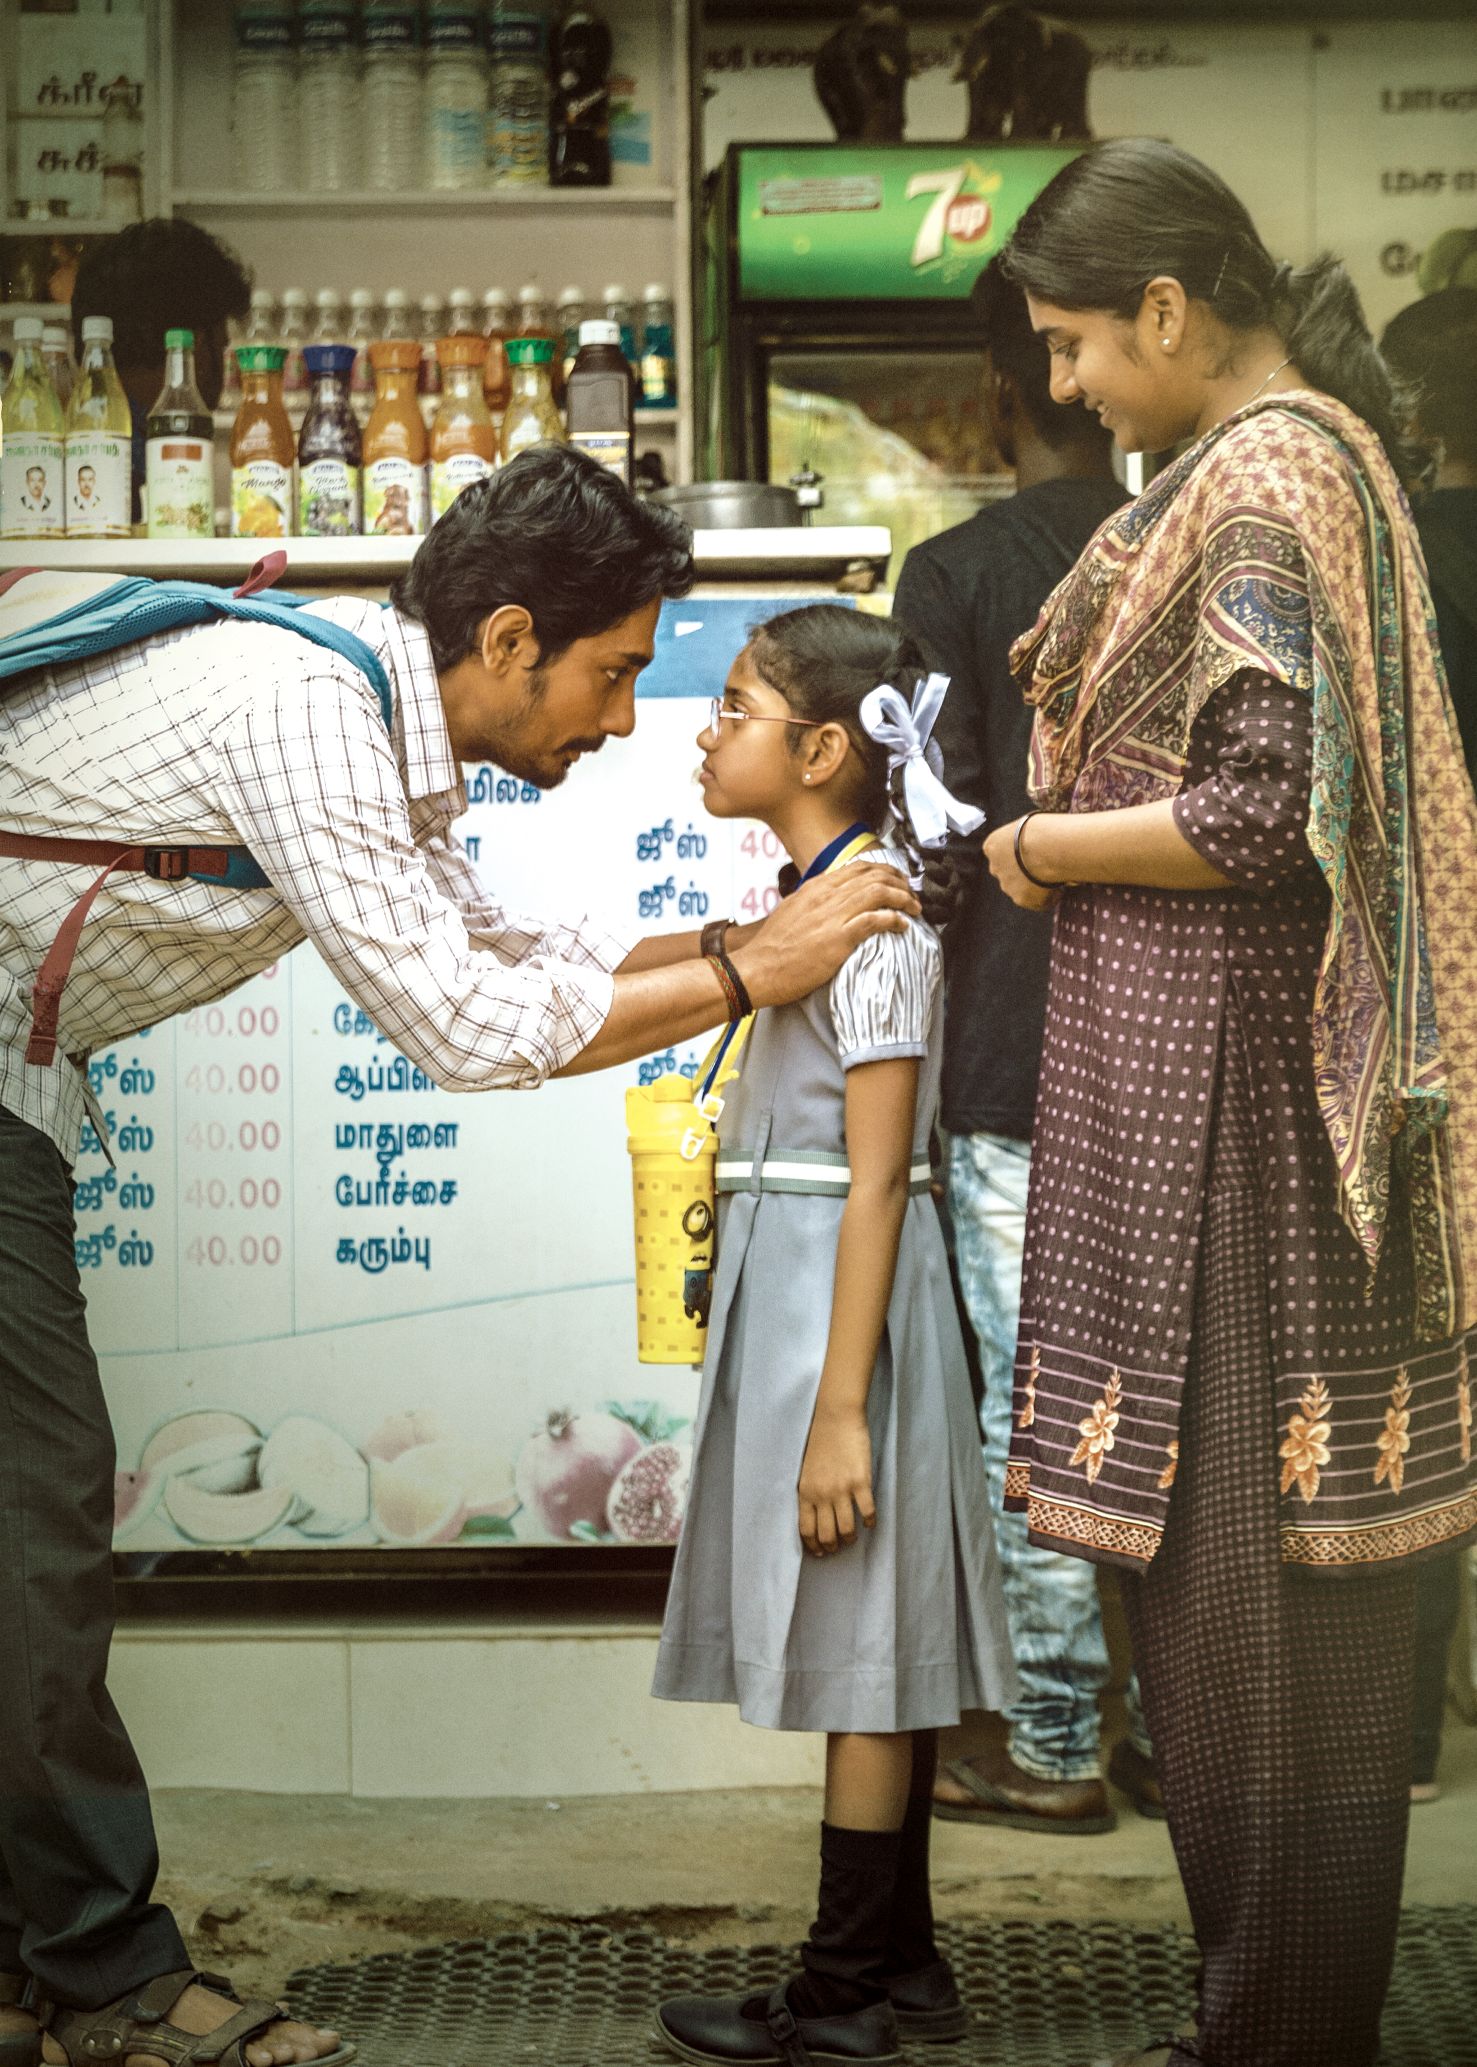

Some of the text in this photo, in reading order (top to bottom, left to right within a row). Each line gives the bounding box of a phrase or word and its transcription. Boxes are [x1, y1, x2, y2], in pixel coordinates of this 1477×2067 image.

[636, 818, 708, 862] ஜூஸ்
[638, 876, 710, 918] ஜூஸ்
[184, 1006, 280, 1037] 40.00
[184, 1063, 281, 1094] 40.00
[184, 1120, 281, 1151] 40.00
[335, 1122, 459, 1164] மாதுளை
[74, 1168, 282, 1211] ஜூஸ் 40.00
[335, 1163, 458, 1207] பேரீச்சை
[74, 1225, 282, 1268] ஜூஸ் 40.00
[335, 1228, 431, 1274] கரும்பு
